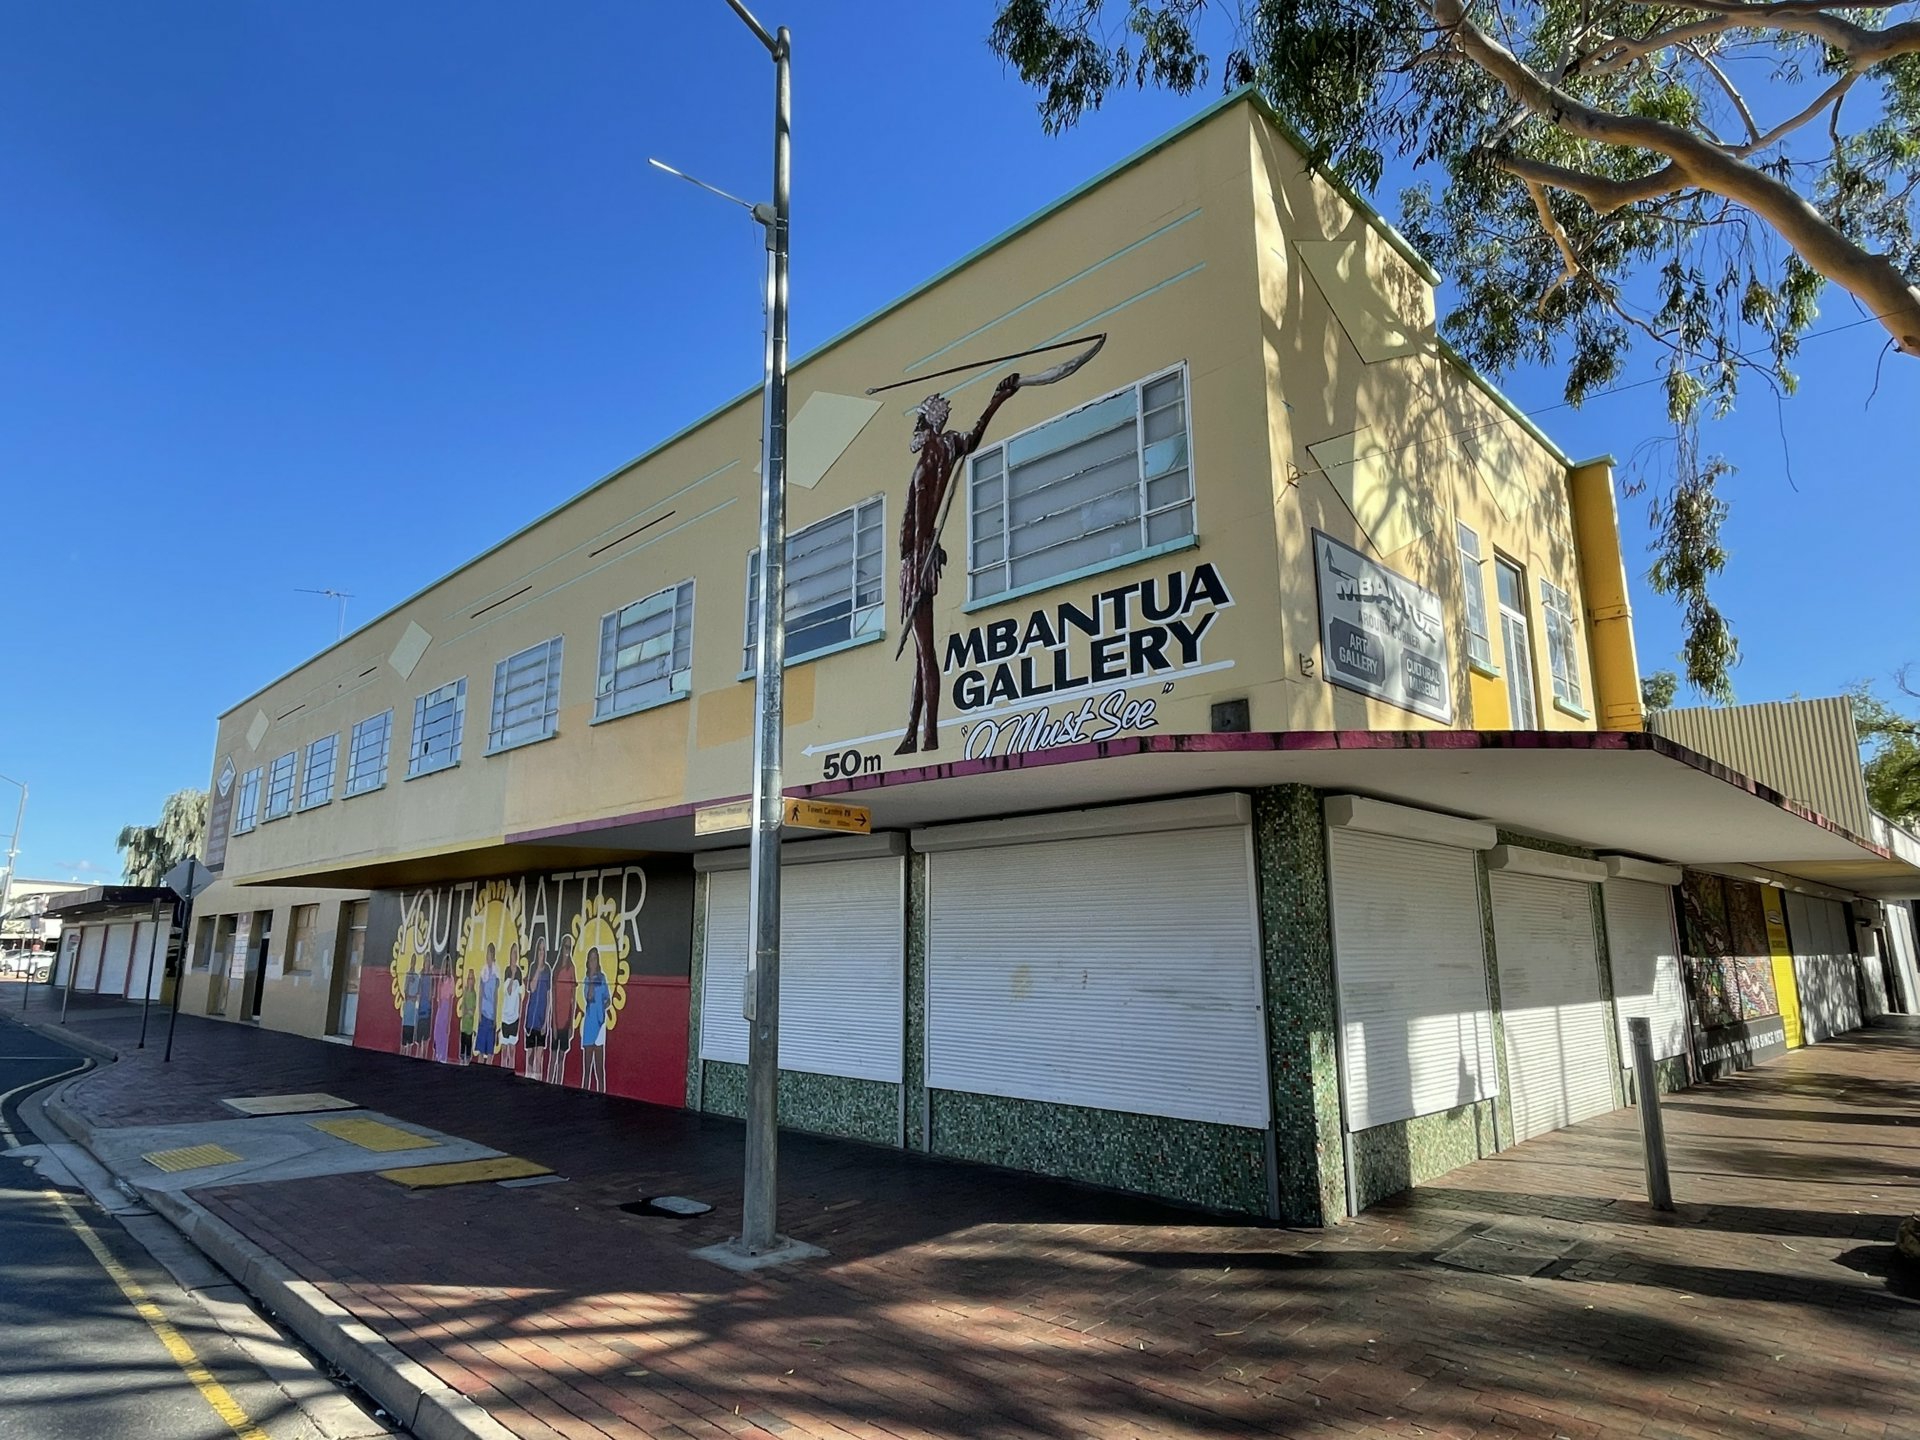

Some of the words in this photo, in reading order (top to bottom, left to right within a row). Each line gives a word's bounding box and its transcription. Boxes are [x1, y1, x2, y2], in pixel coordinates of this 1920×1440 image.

[943, 562, 1235, 676] MBANTUA
[1358, 609, 1390, 635] AROUND
[1391, 625, 1420, 648] CORNER
[1350, 633, 1367, 653] ART
[952, 611, 1219, 712] GALLERY
[1340, 646, 1378, 675] GALLERY
[1407, 658, 1440, 685] CULTURAL
[1409, 676, 1439, 700] MUSEUM
[999, 697, 1097, 756] Must
[823, 751, 881, 780] 50m
[400, 880, 489, 953] YOUTH
[500, 866, 646, 953] MATTER
[1701, 1043, 1731, 1065] LEARNING
[1760, 1031, 1775, 1047] SINCE
